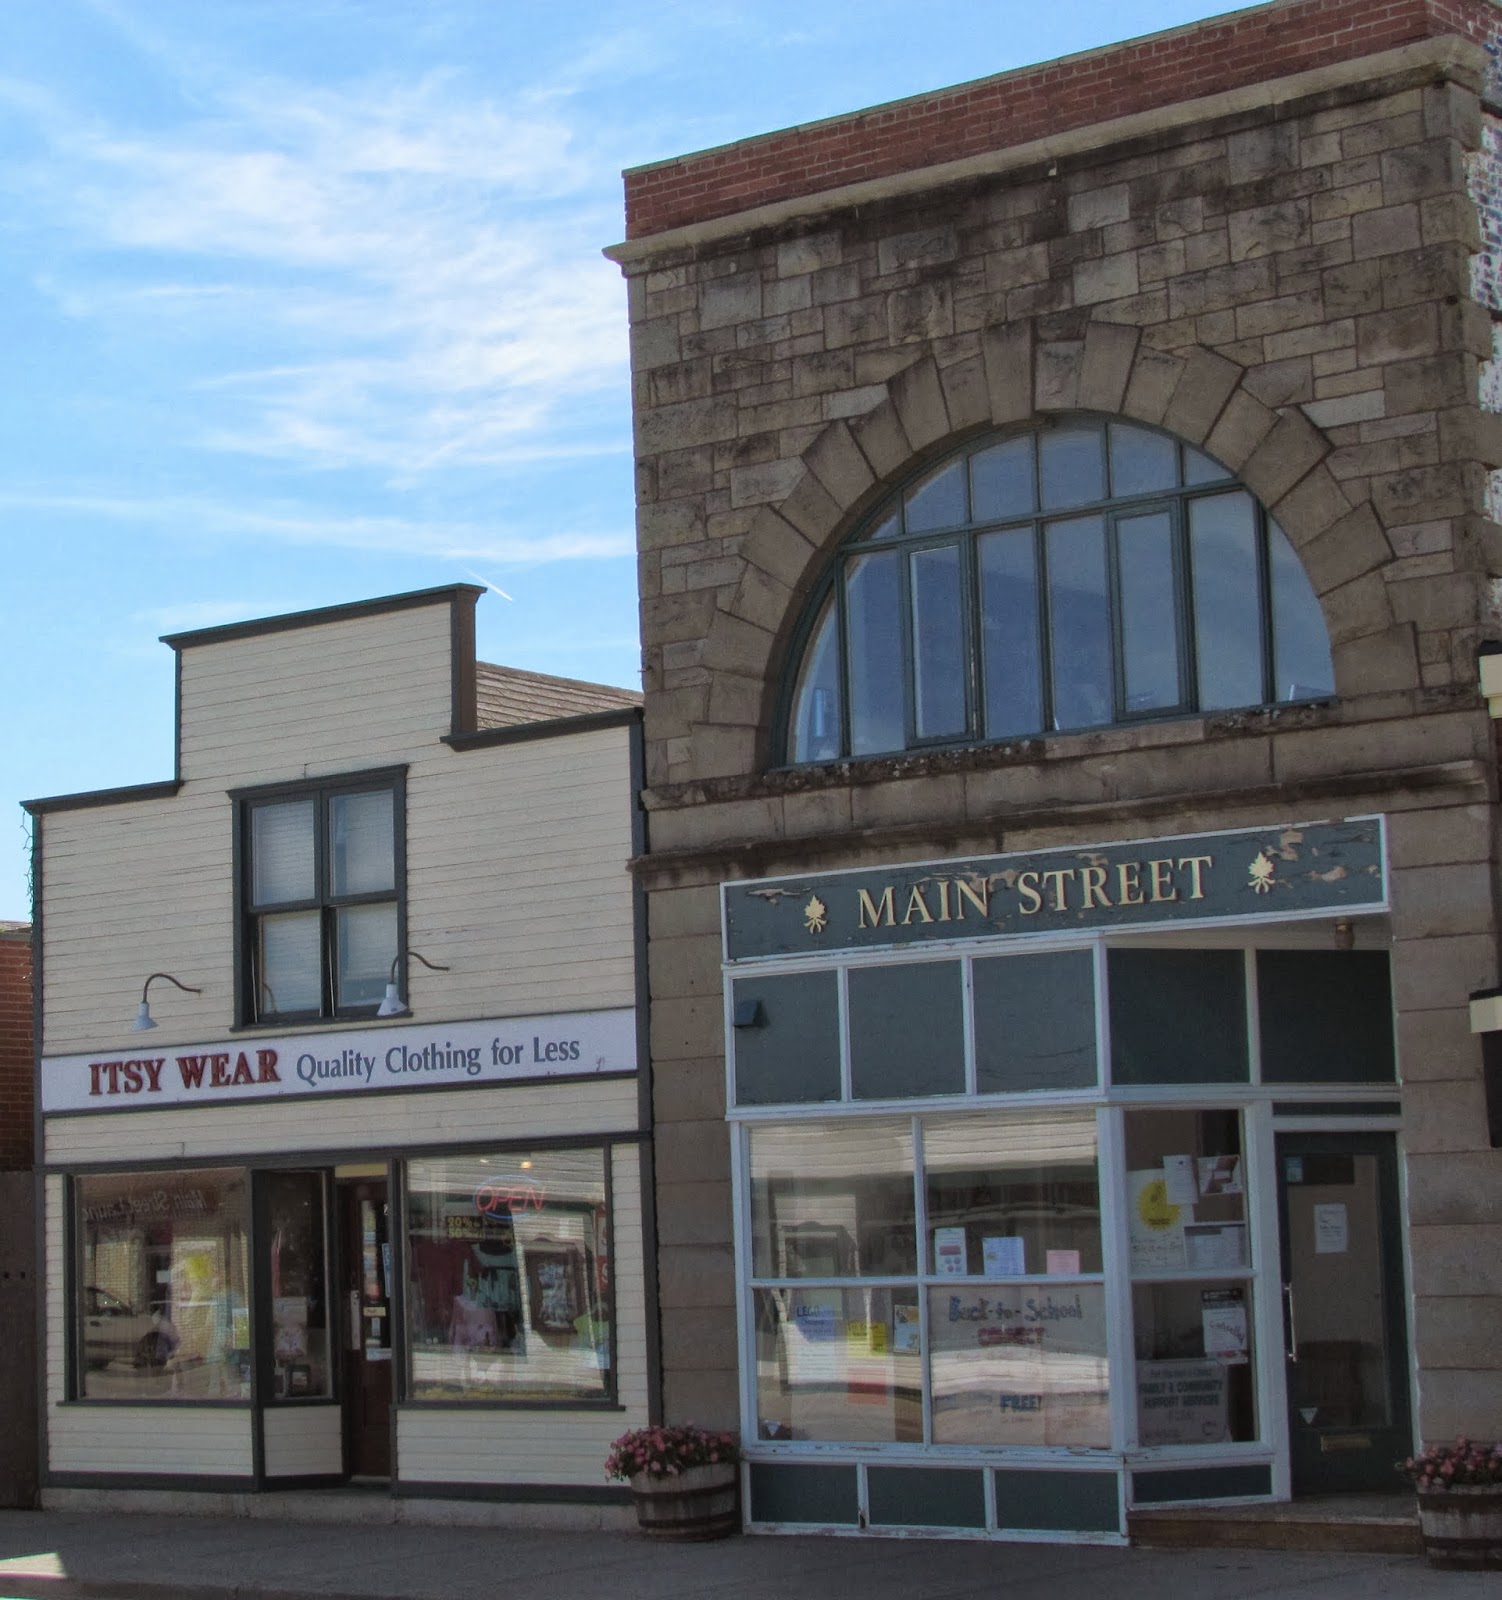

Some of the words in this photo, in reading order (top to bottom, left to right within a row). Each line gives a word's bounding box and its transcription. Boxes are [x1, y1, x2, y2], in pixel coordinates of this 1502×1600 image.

[857, 876, 991, 930] MAIN
[1016, 855, 1213, 916] STREET
[88, 1058, 166, 1097] ITSY
[175, 1049, 281, 1089] WEAR
[296, 1049, 377, 1087] Quality
[385, 1041, 483, 1076] Clothing
[491, 1037, 525, 1066] for
[532, 1036, 581, 1063] Less
[475, 1184, 547, 1212] OPEN
